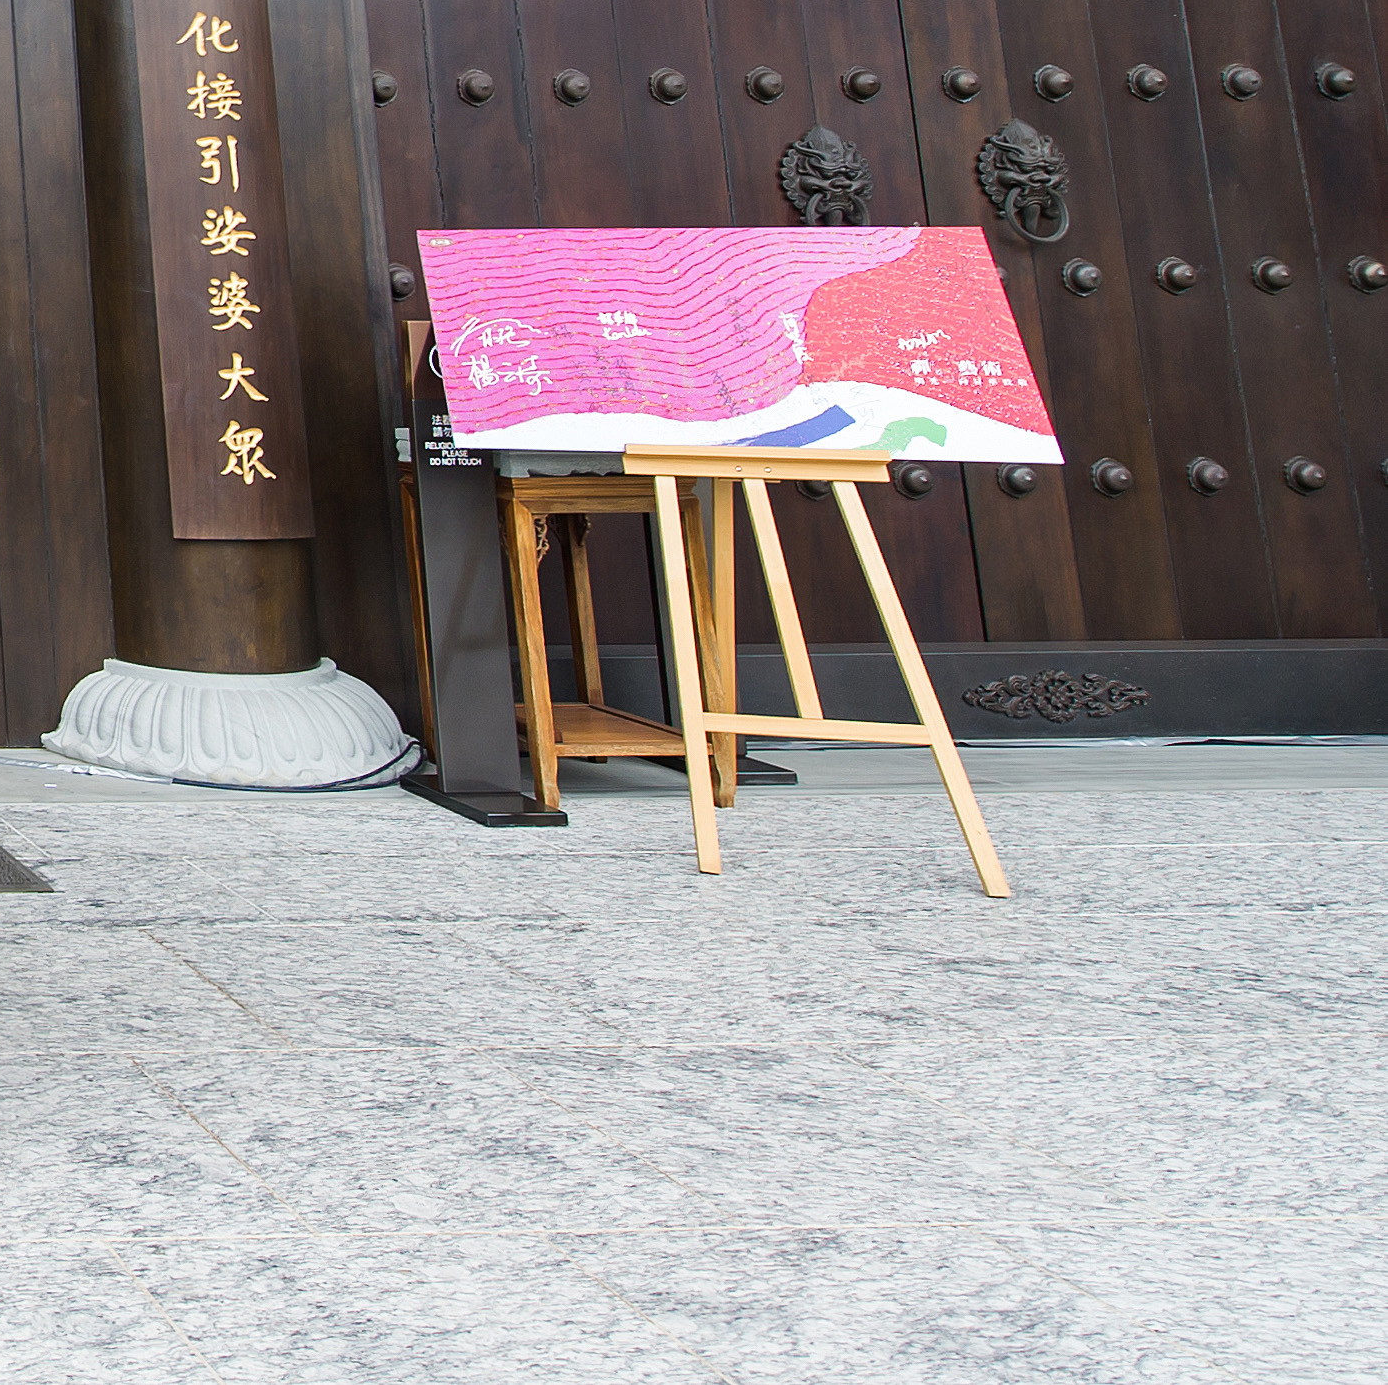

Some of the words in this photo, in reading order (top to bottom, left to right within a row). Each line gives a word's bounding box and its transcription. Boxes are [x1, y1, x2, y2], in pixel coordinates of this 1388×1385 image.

[425, 442, 455, 450] RELIGIO
[441, 449, 469, 458] PLEASE
[429, 458, 441, 466] DO
[442, 458, 456, 466] NOT
[457, 458, 482, 466] TOUCH
